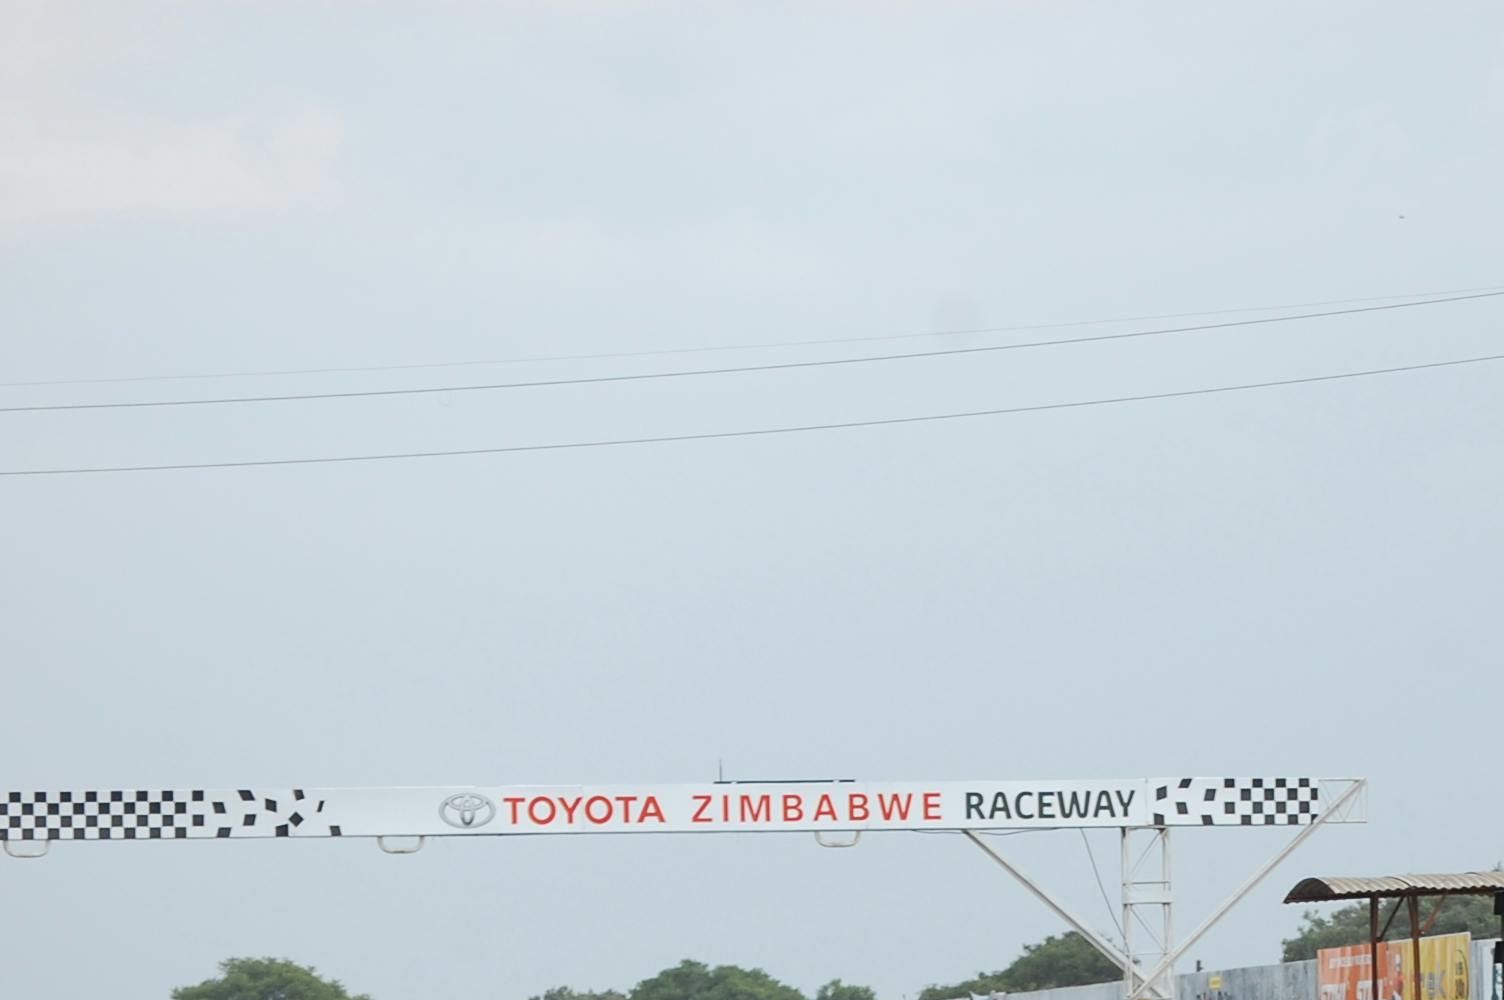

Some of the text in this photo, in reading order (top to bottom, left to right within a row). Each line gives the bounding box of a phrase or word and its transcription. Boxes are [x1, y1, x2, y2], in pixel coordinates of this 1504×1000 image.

[502, 789, 1136, 826] TOYOTA ZIMBABWE RACEWAY
